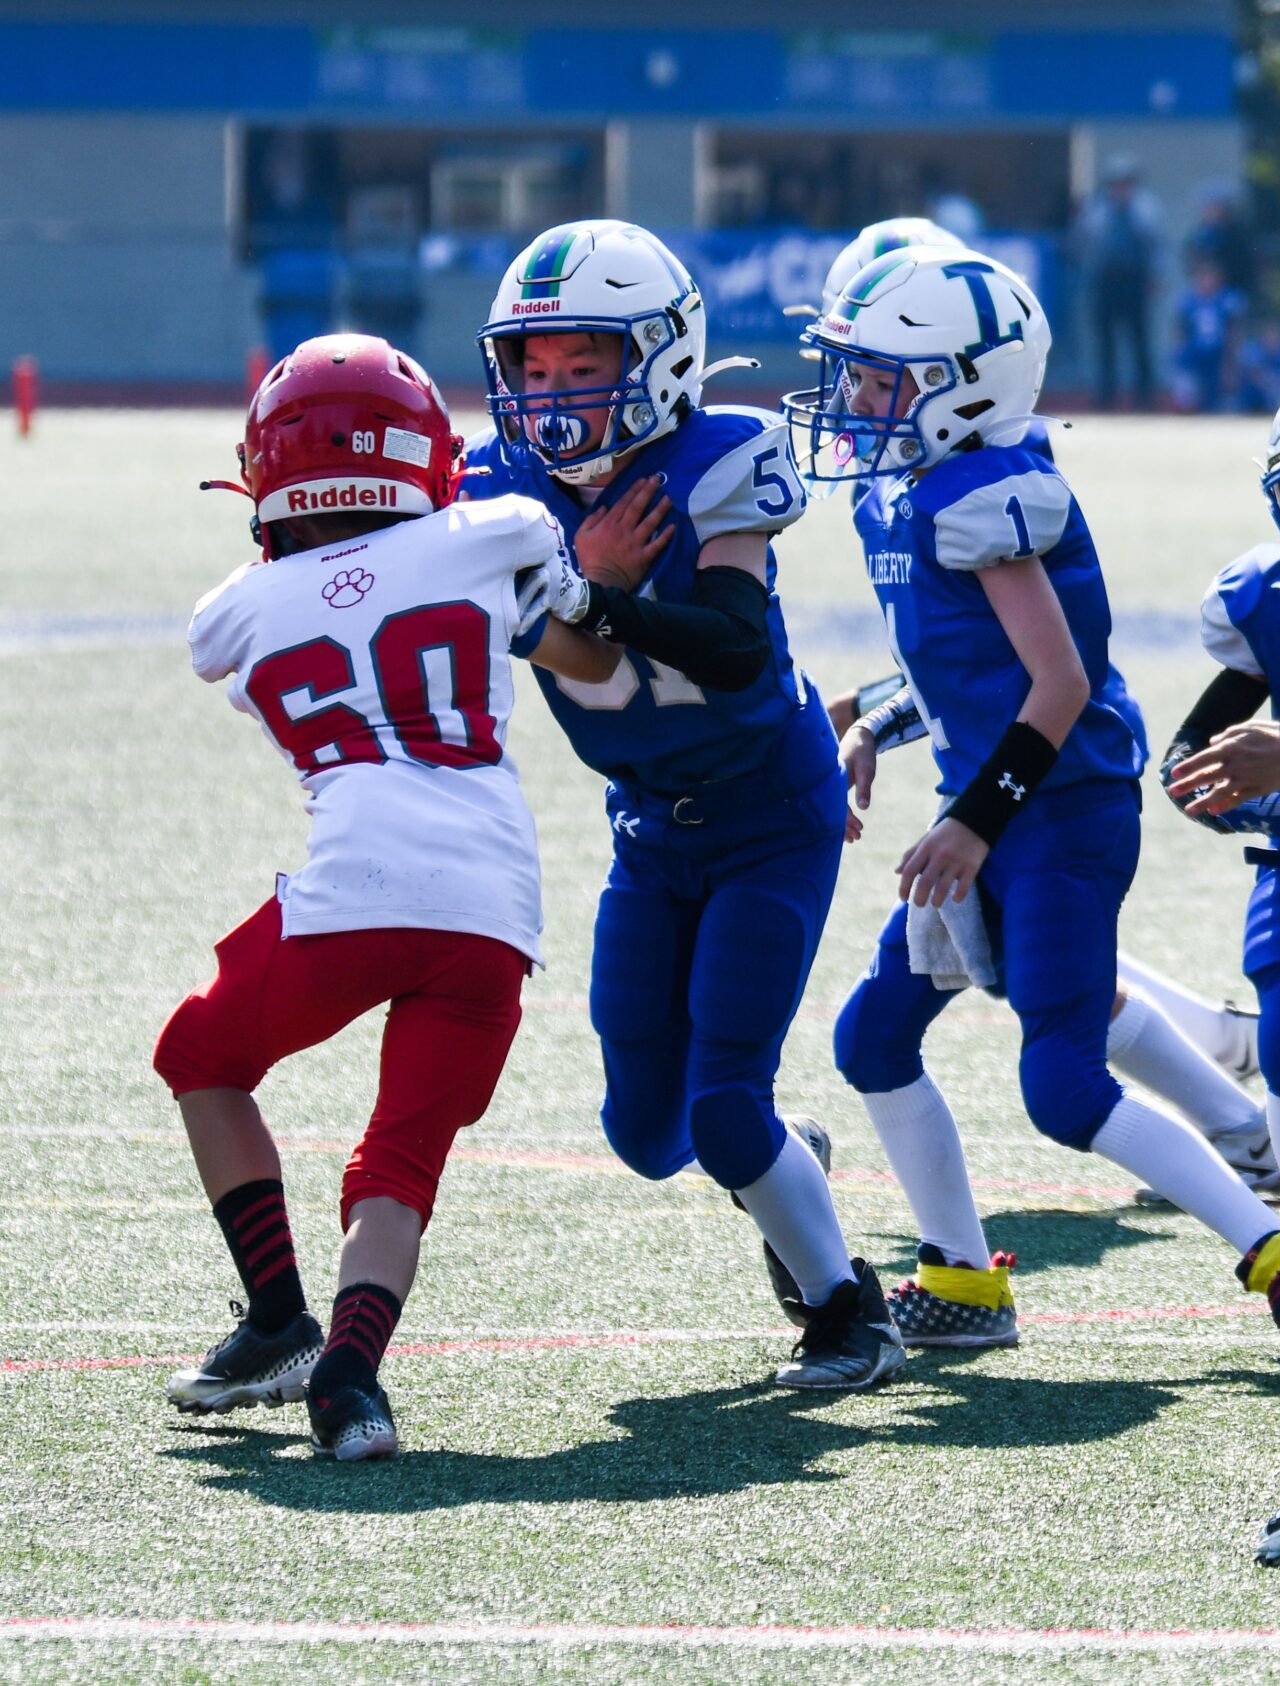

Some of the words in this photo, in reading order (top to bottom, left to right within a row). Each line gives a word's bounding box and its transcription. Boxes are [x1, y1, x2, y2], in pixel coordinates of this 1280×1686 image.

[511, 300, 561, 315] Riddell
[939, 260, 1023, 360] L
[352, 431, 375, 454] 60
[287, 484, 398, 513] Riddell
[1003, 492, 1036, 559] 1
[320, 543, 369, 563] Riddell
[868, 552, 912, 585] LIBERTY
[246, 598, 506, 776] 60
